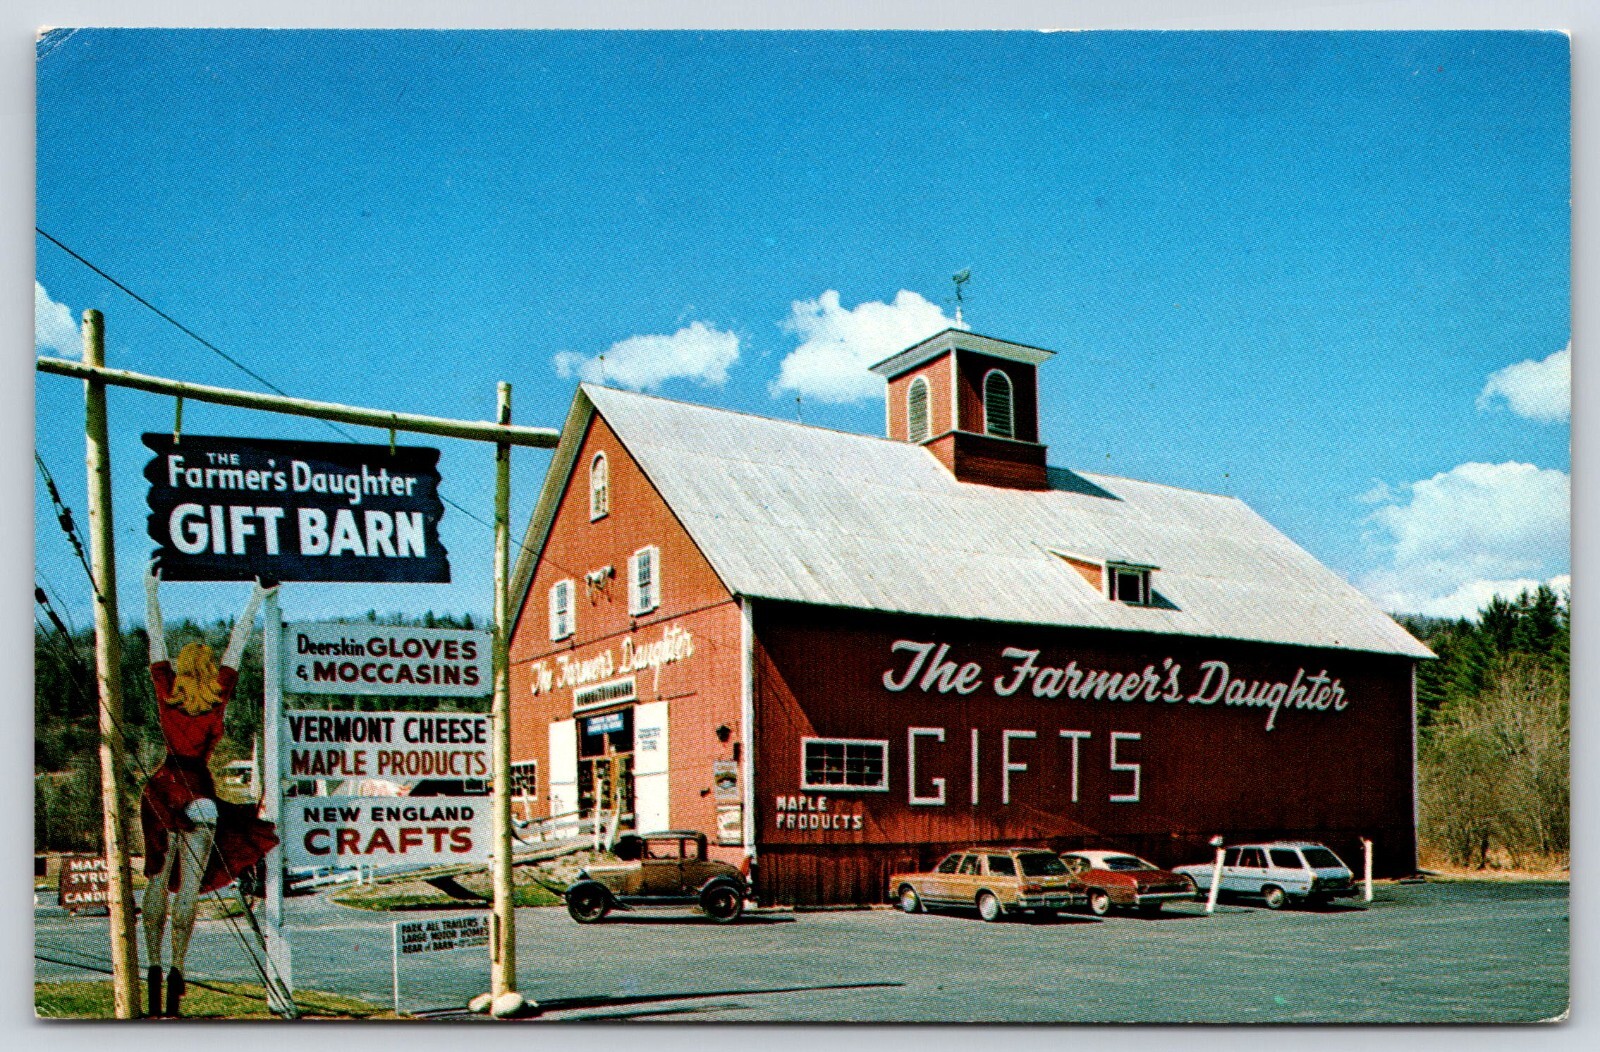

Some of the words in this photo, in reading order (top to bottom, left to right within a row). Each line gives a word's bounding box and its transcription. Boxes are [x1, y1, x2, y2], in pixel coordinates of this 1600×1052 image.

[206, 452, 240, 466] THE
[168, 454, 286, 491] Farmer's
[291, 460, 417, 505] Daughter
[169, 503, 284, 556] GIFT
[298, 507, 426, 558] BARN
[297, 633, 365, 656] Deerskin
[366, 637, 477, 660] GLOVES
[619, 622, 695, 692] Daughter
[296, 665, 308, 681] &
[313, 661, 480, 686] MOCCASINS
[883, 640, 983, 695] The
[994, 647, 1184, 703] Farmer's
[1187, 660, 1349, 732] Daughter
[288, 716, 395, 743] VERMONT
[403, 718, 487, 744] CHEESE
[290, 750, 367, 776] MAPLE
[377, 751, 487, 776] PRODUCTS
[908, 726, 1142, 806] GIFTS
[303, 807, 361, 823] NEW
[371, 806, 475, 822] ENGLAND
[776, 795, 828, 811] MAPLE
[776, 813, 863, 830] PRODUCTS
[303, 826, 473, 856] CRAFTS
[70, 860, 108, 871] MAPL
[70, 873, 108, 884] SYRU
[65, 892, 107, 904] CANDI
